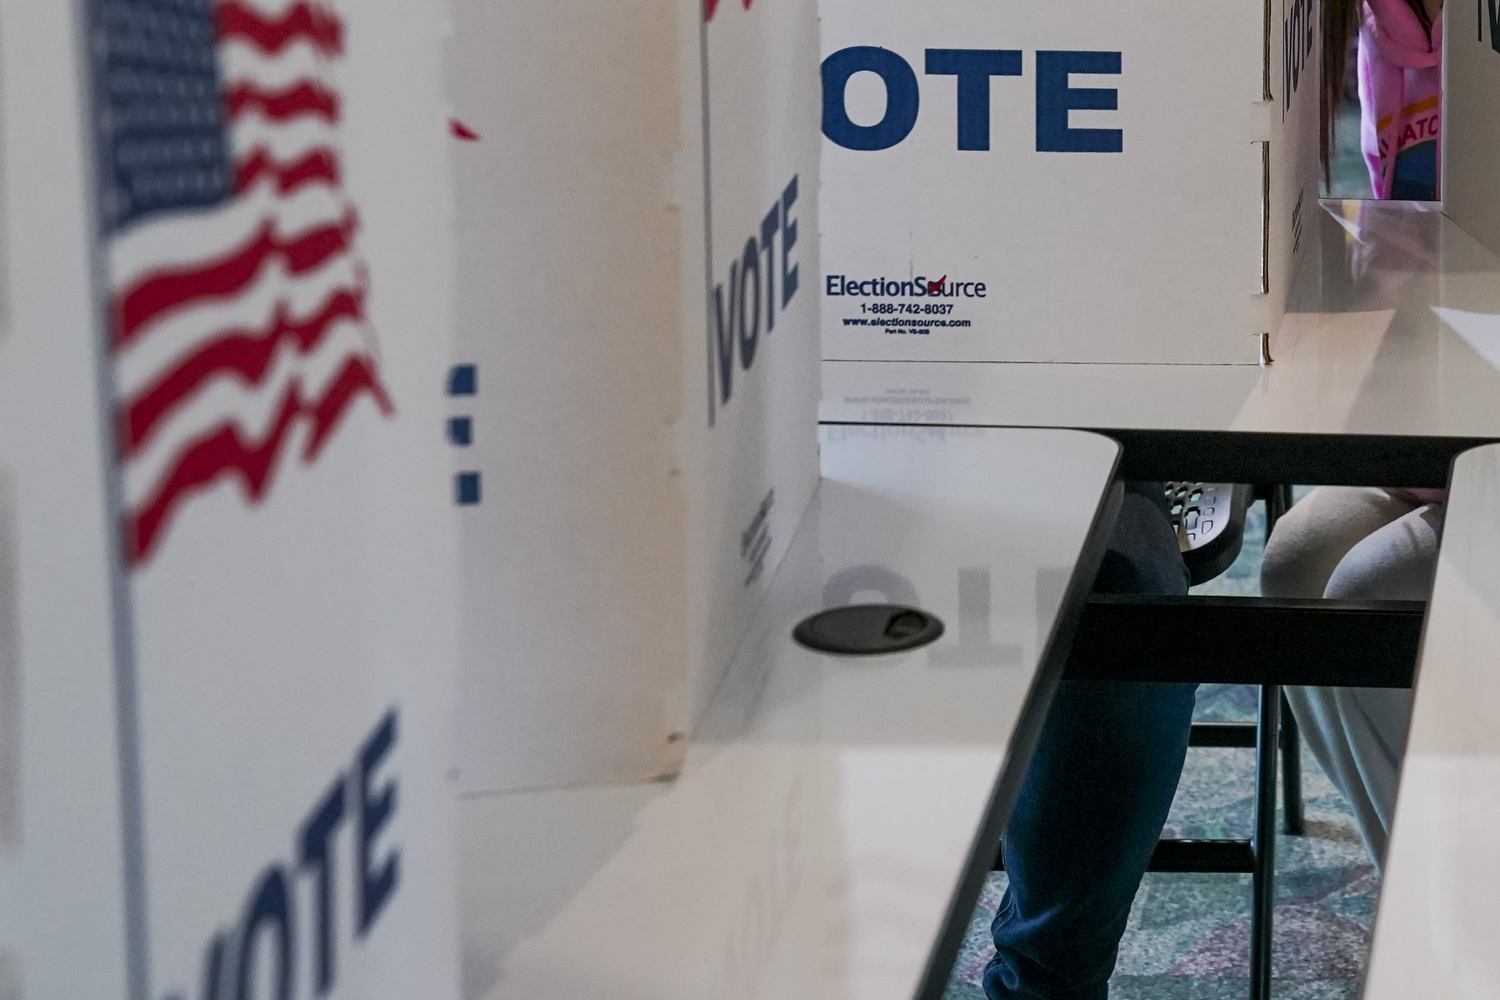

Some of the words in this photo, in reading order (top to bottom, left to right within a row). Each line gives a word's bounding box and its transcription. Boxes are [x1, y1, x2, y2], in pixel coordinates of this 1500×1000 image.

[820, 45, 1123, 153] OTE
[712, 173, 799, 405] VOTE
[826, 274, 987, 298] ElectionSource
[860, 303, 954, 314] 1-888-742-8037
[842, 317, 971, 327] www.electionsource.com
[170, 706, 400, 1000] OTE
